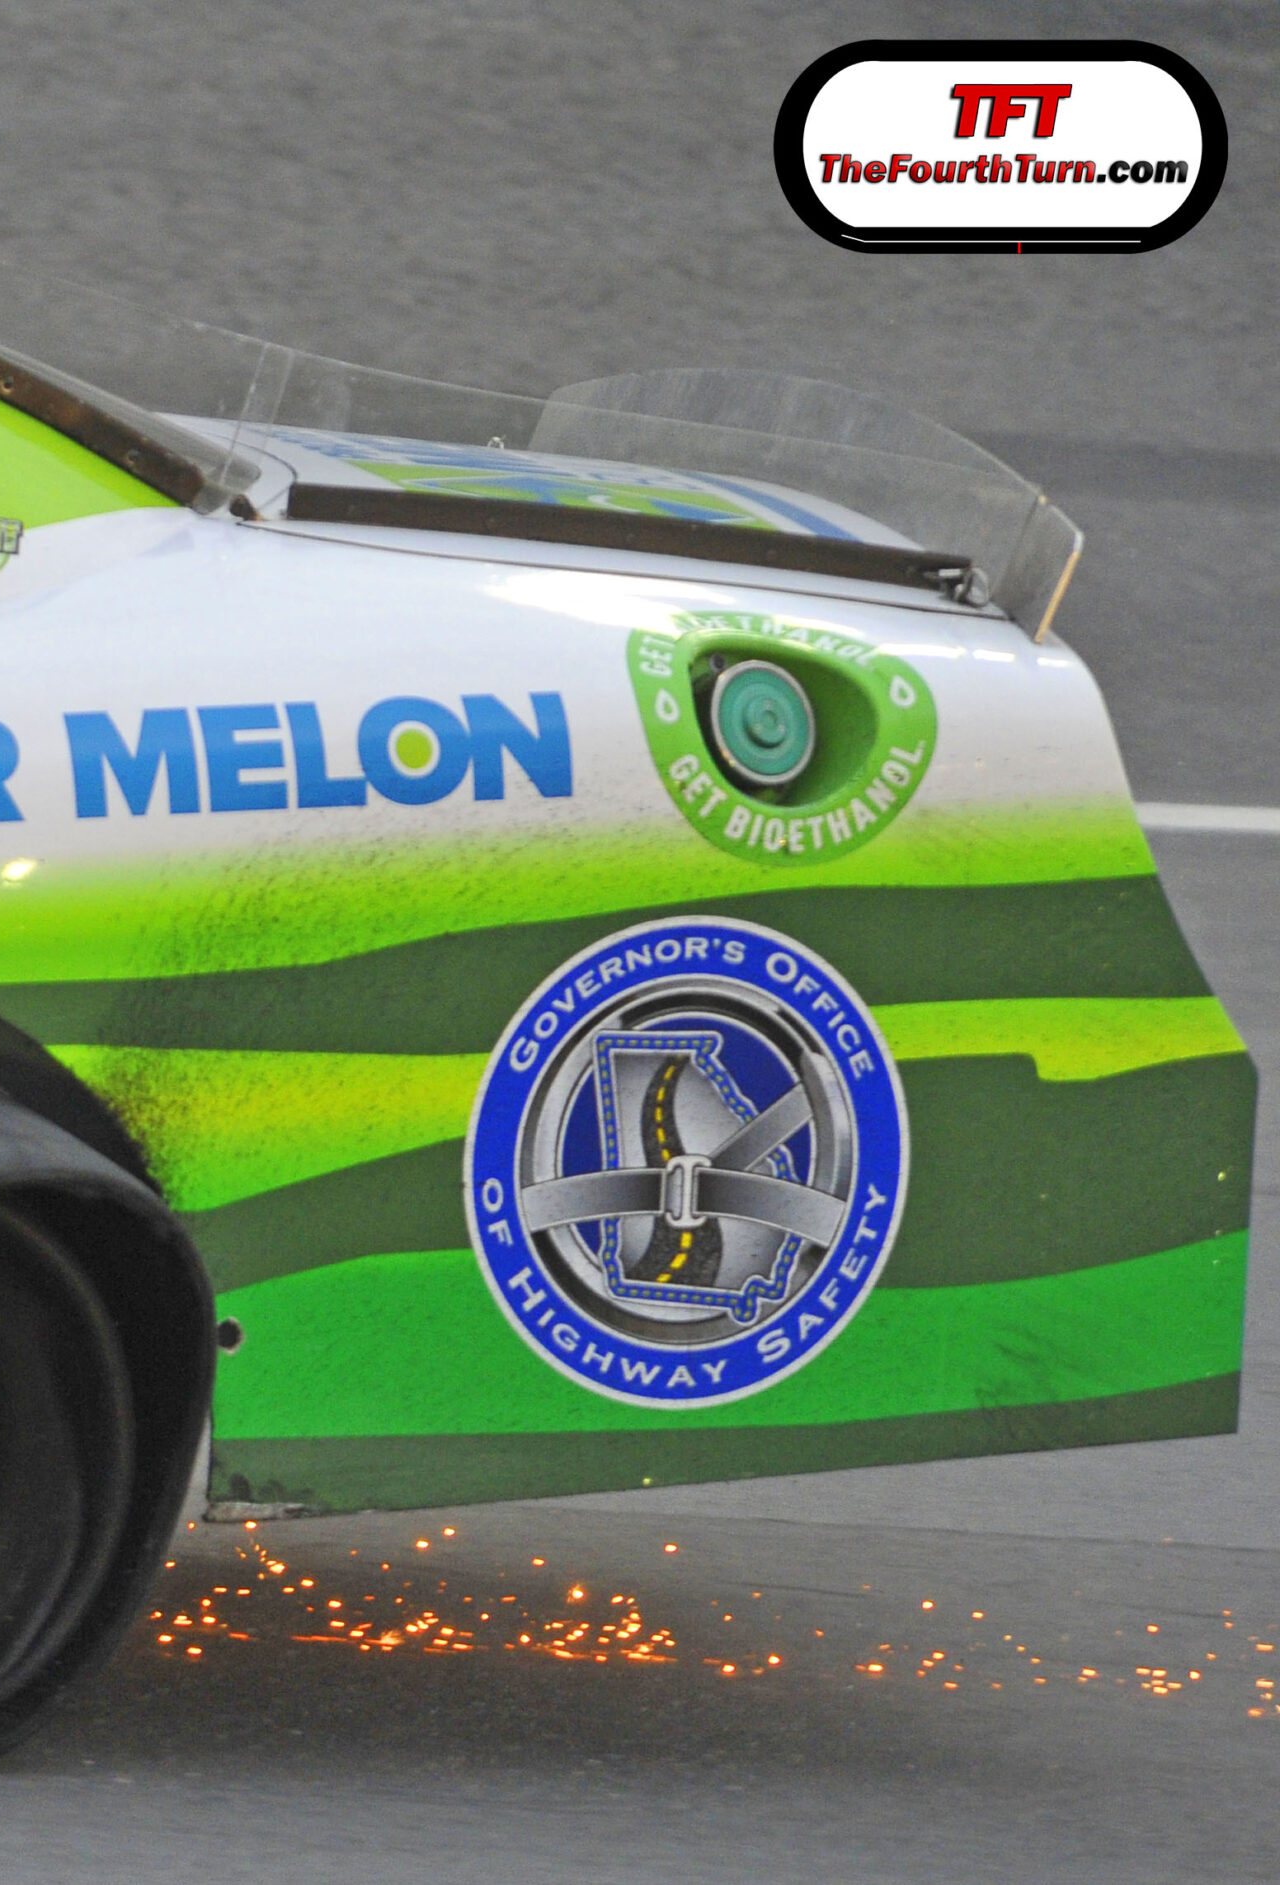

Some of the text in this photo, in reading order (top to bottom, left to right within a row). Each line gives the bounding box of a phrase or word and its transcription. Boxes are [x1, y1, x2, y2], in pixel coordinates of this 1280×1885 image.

[637, 634, 673, 677] GET
[62, 690, 575, 819] MELON
[668, 739, 927, 855] GET BIOETHANOL
[508, 935, 876, 1081] GOVERNOR'S OFFICE
[480, 1177, 888, 1389] OF HIGHWAY SAFETY
